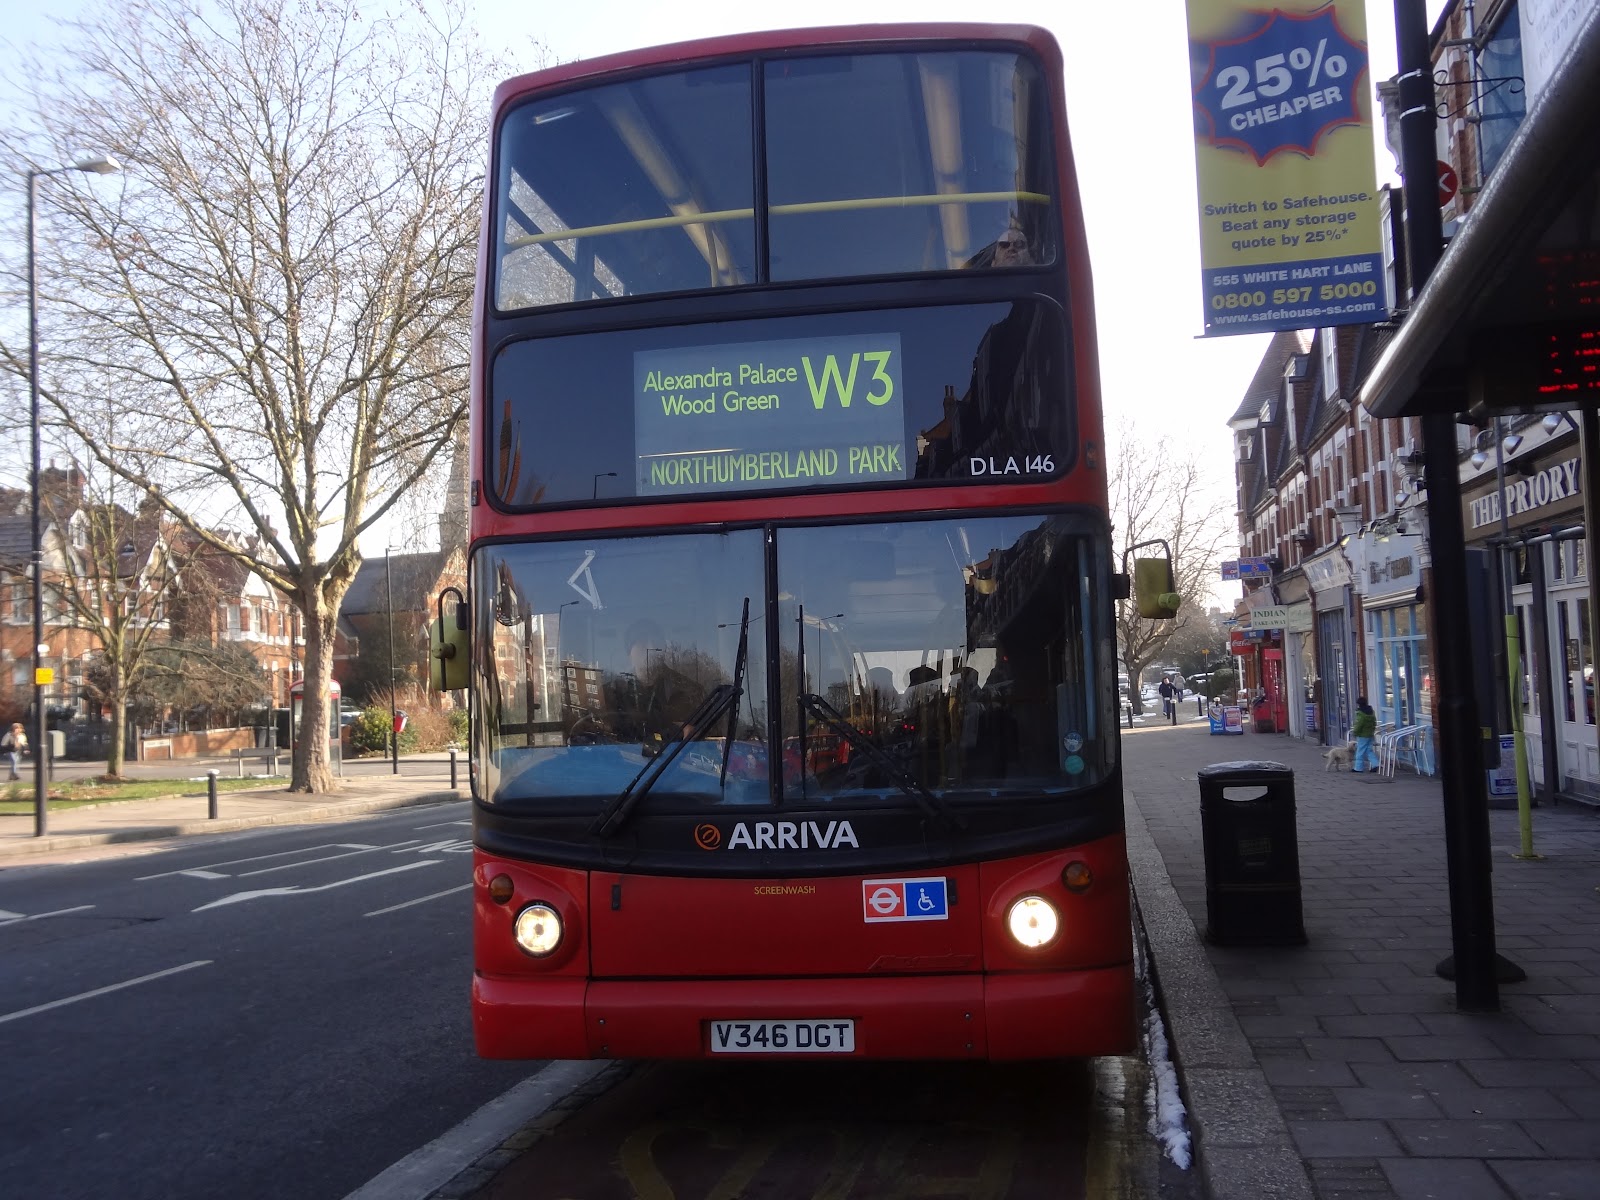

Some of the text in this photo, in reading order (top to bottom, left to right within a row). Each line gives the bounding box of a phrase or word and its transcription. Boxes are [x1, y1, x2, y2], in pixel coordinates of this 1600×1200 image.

[1216, 38, 1347, 109] 25%
[1230, 86, 1343, 132] CHEAPER
[1205, 191, 1372, 216] Switch to Safehouse.
[1222, 210, 1357, 232] Beat any storage
[1231, 236, 1276, 251] quote
[1281, 233, 1299, 247] by
[1213, 262, 1372, 286] 555 WHITE HART LANE
[1212, 280, 1377, 310] 0800 597 5000
[1214, 301, 1375, 325] www.safehouse-ss.com
[643, 363, 798, 393] Alexandra Palace
[801, 350, 894, 410] W3
[661, 391, 780, 416] Wood Green
[651, 443, 902, 486] NORTHUMBERLAND PARK
[970, 454, 1055, 476] DLA 146
[1469, 457, 1579, 529] THE PRIORY
[1254, 609, 1286, 618] INDIAN
[727, 820, 860, 850] ARRIVA
[754, 885, 816, 895] SCREENWASH
[716, 1023, 850, 1048] V346 DGT
